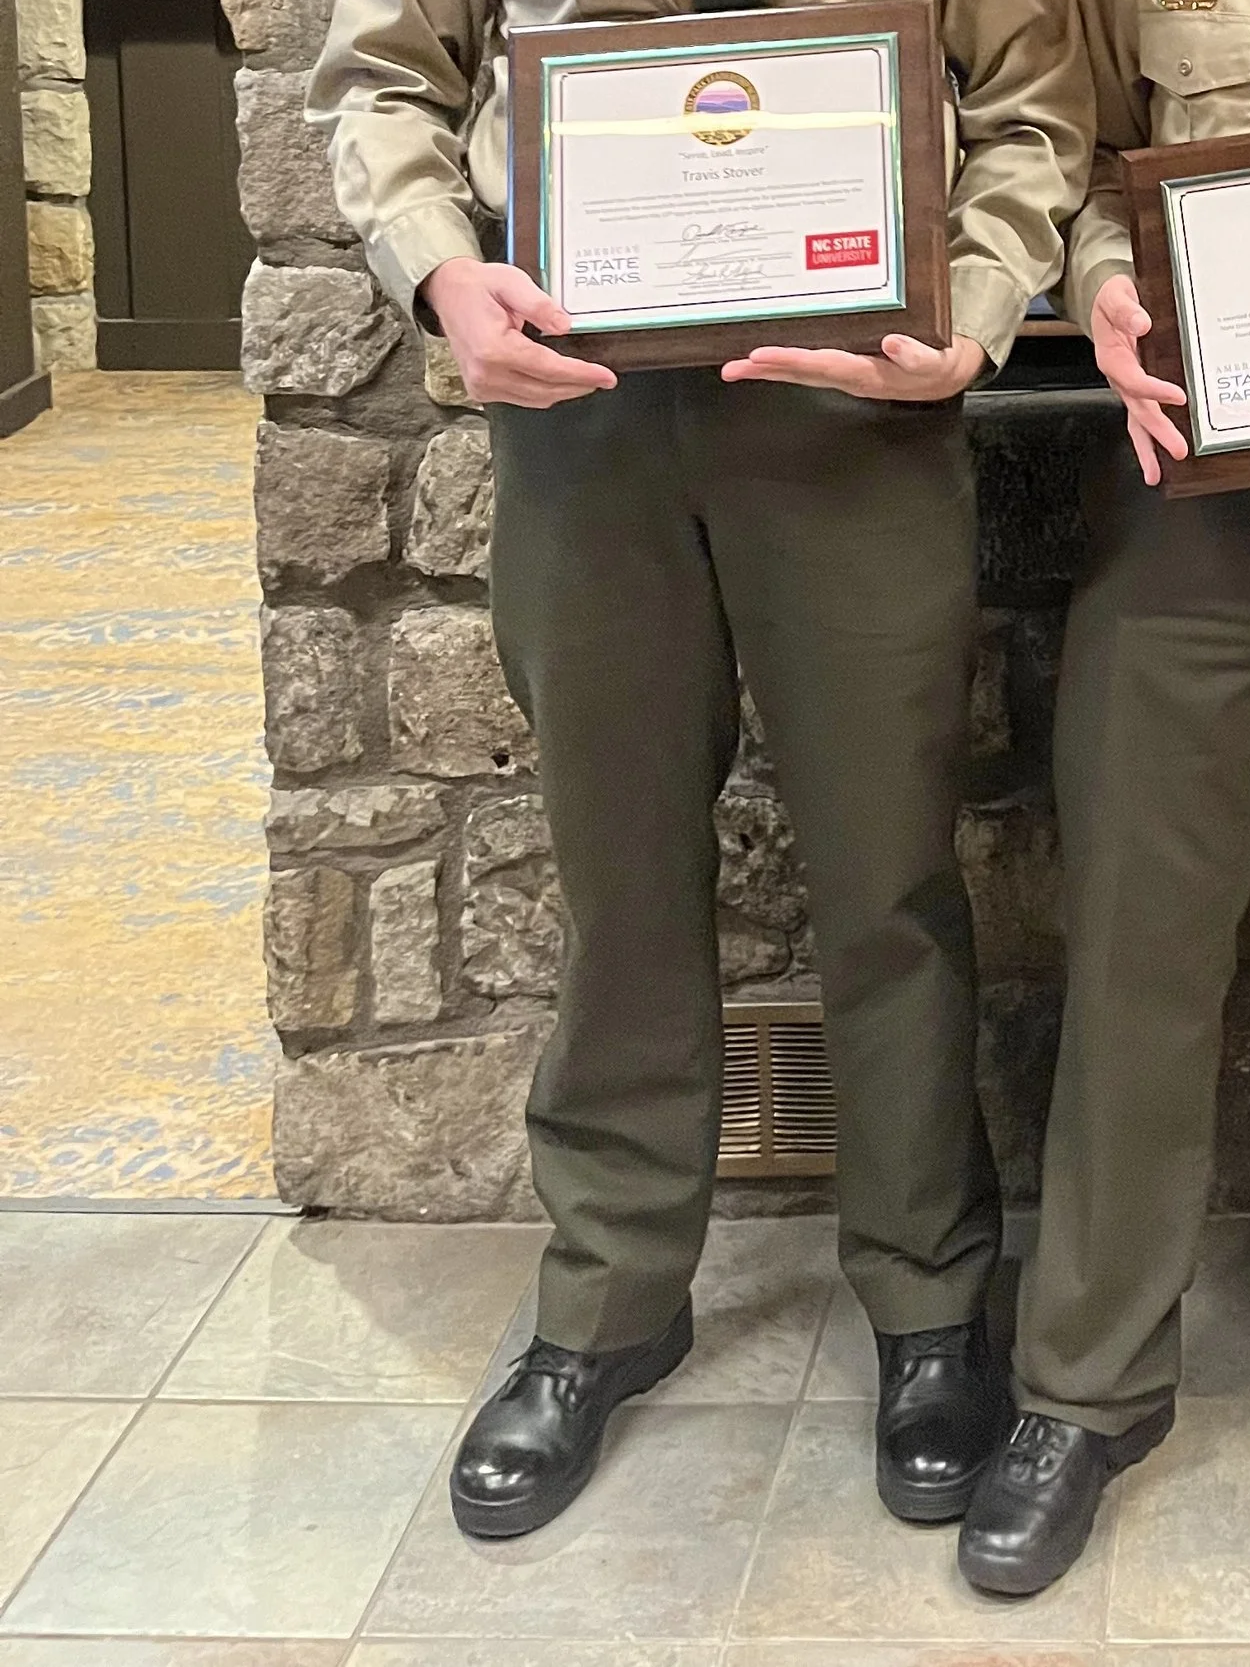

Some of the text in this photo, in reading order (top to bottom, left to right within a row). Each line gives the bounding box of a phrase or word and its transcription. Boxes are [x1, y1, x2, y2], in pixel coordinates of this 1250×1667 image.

[682, 167, 766, 183] Travis Stover
[811, 235, 872, 253] NC STATE
[574, 257, 640, 273] STATE
[812, 249, 873, 265] UNIVERSITY
[574, 271, 642, 288] PARKS
